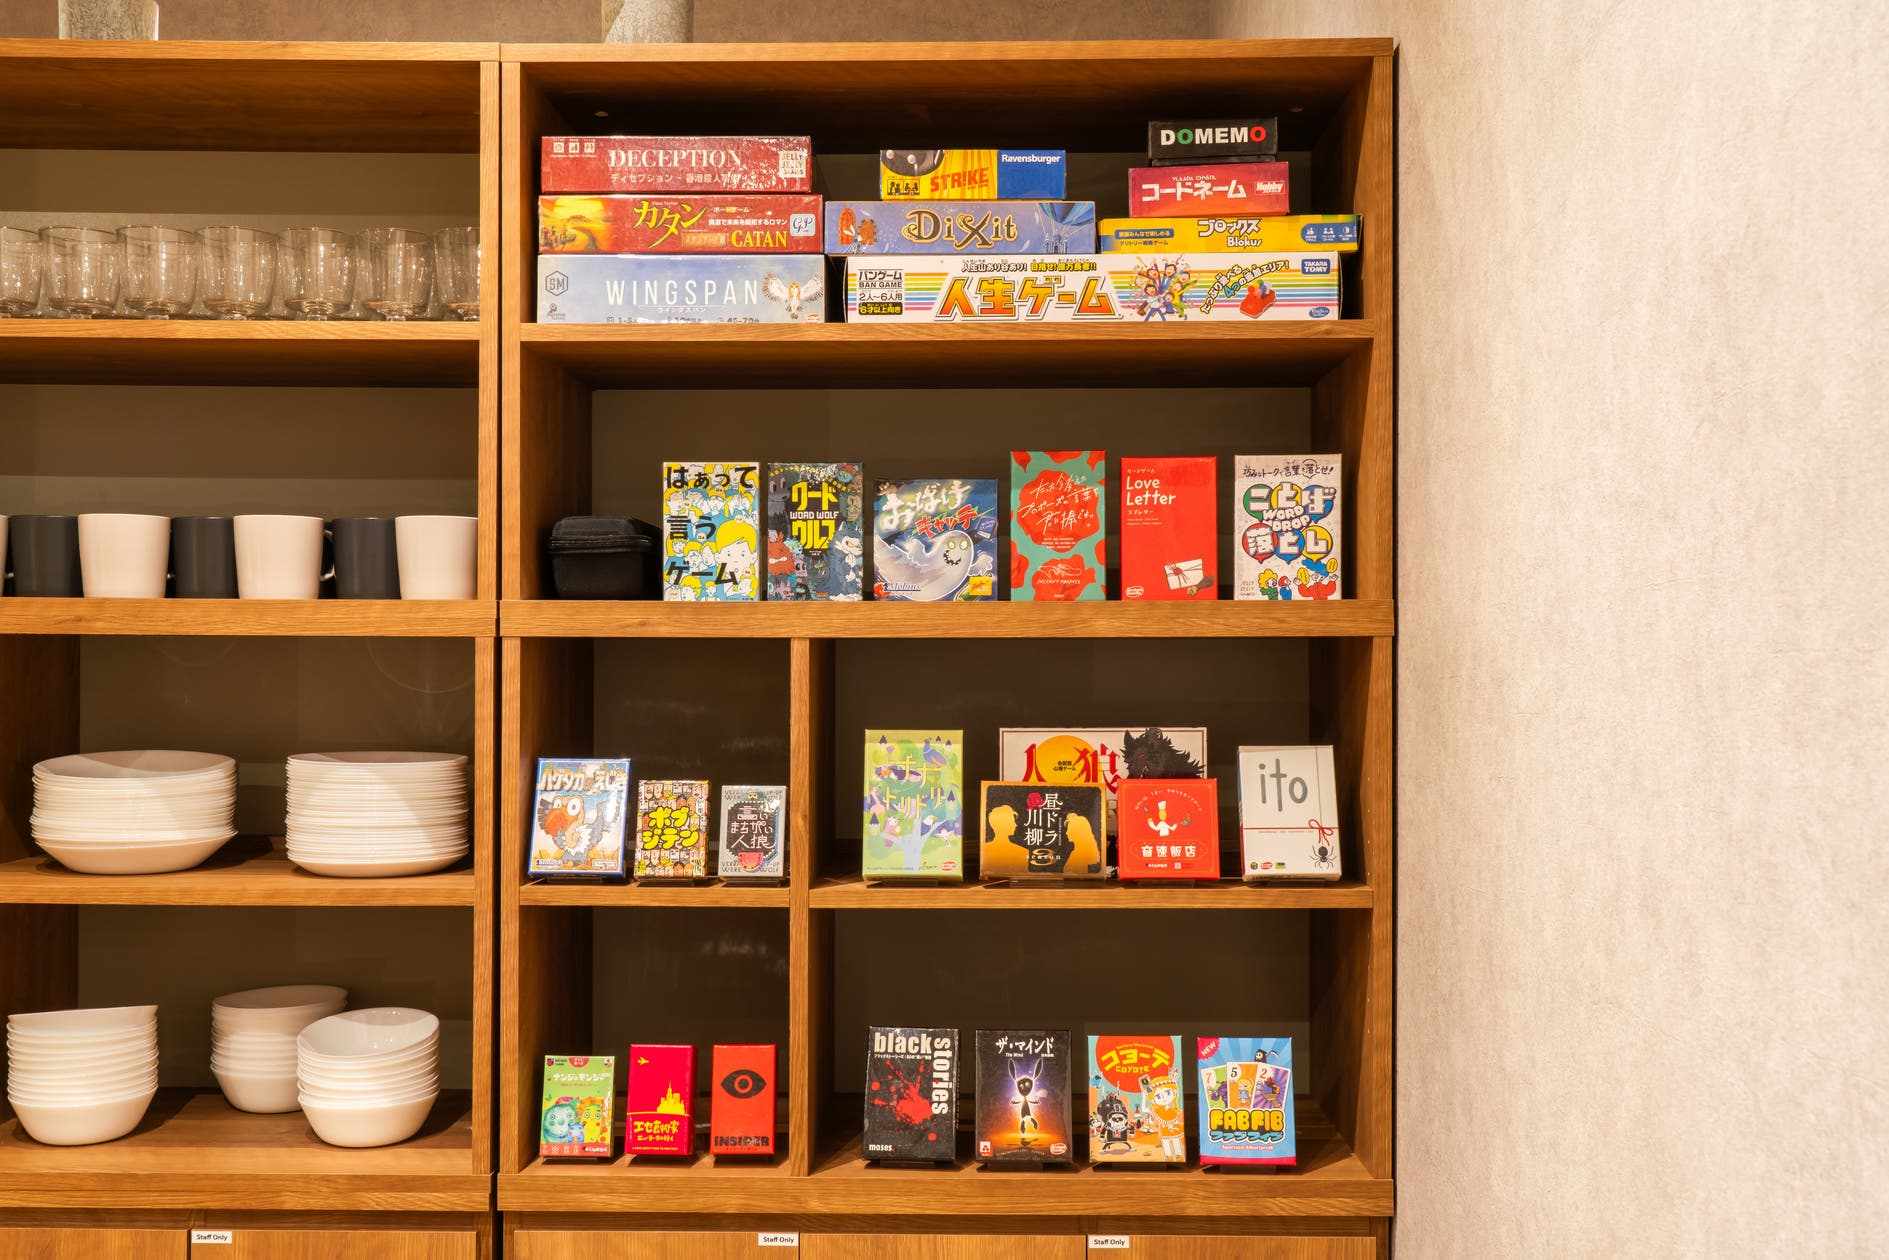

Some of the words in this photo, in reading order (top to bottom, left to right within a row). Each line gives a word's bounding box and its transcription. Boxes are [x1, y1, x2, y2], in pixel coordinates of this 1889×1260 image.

[1161, 125, 1267, 146] DOMEMO
[608, 149, 742, 168] DECEPTION
[1001, 154, 1061, 164] Ravensburger
[611, 173, 673, 184] ディセプション
[1142, 180, 1247, 202] コードネーム
[633, 200, 707, 248] カタン
[1198, 218, 1262, 238] ブロックス
[731, 230, 787, 248] CATAN
[1227, 236, 1263, 249] Blokus
[606, 279, 758, 305] WINGSPAN
[935, 275, 1122, 321] 人生ゲーム
[667, 466, 757, 489] はぁって
[1126, 476, 1160, 490] Love
[791, 481, 839, 511] ワード
[881, 480, 972, 532] おばけ
[1126, 490, 1176, 506] Letter
[1249, 482, 1337, 515] ことば
[790, 511, 814, 519] WORD
[816, 511, 839, 519] WOLF
[915, 503, 978, 539] キャッチ
[1262, 505, 1305, 521] WORD
[1271, 514, 1312, 532] DROP
[667, 515, 717, 540] 言う
[791, 519, 836, 550] ウルフ
[1246, 526, 1329, 556] 落とし
[666, 560, 738, 586] ゲーム
[1258, 758, 1308, 812] ito
[1024, 809, 1043, 846] 川柳
[1039, 793, 1063, 846] 昼ドラ
[642, 828, 699, 850] ジテン
[731, 835, 776, 849] 人狼
[874, 1032, 932, 1054] black
[995, 1036, 1054, 1055] ザ・マインド
[1200, 1041, 1216, 1056] NEW
[1101, 1048, 1170, 1071] コヨーテ
[1115, 1065, 1150, 1074] COYOTE
[931, 1037, 953, 1115] stories
[1206, 1072, 1212, 1084] 7
[1230, 1067, 1238, 1078] 5
[1260, 1068, 1267, 1079] 2
[1209, 1109, 1250, 1131] FAB
[1250, 1109, 1284, 1131] FIB
[713, 1135, 770, 1147] INSIDER
